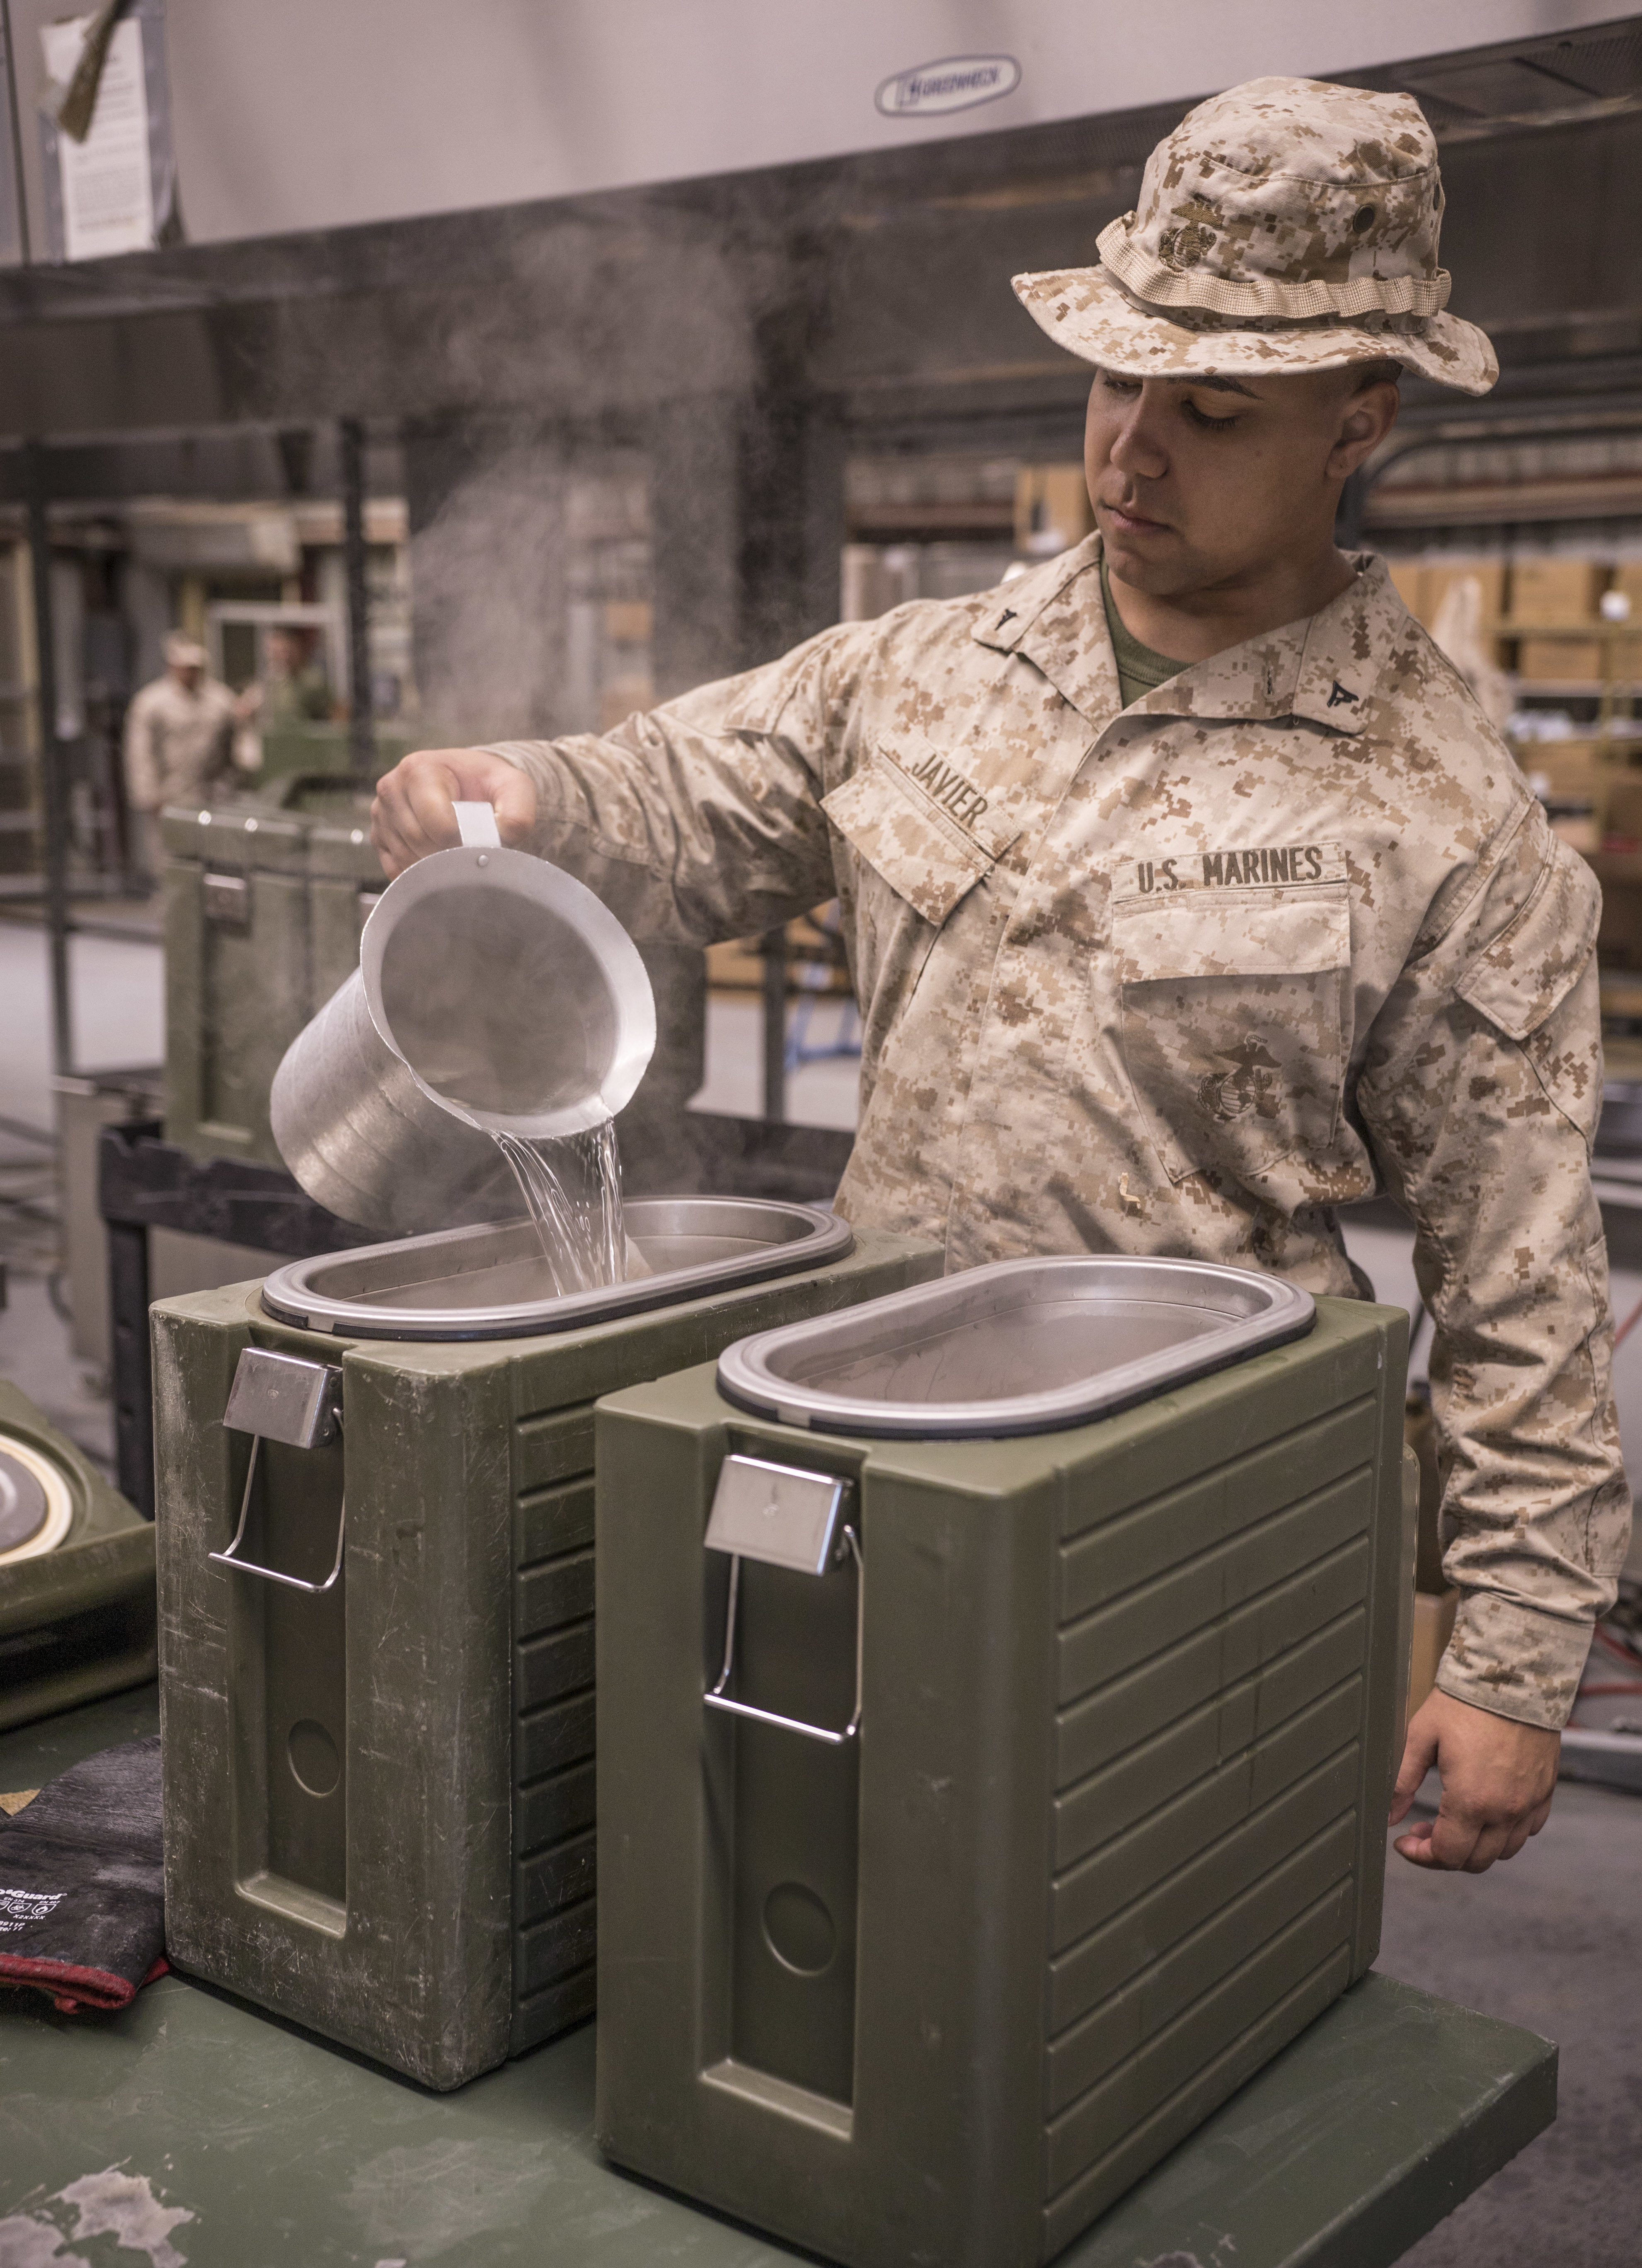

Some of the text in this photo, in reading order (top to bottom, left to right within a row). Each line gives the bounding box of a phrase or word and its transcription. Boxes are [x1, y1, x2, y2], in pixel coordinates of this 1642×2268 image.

[912, 753, 988, 829] JAVIER
[1138, 846, 1322, 894] U.S. MARINES
